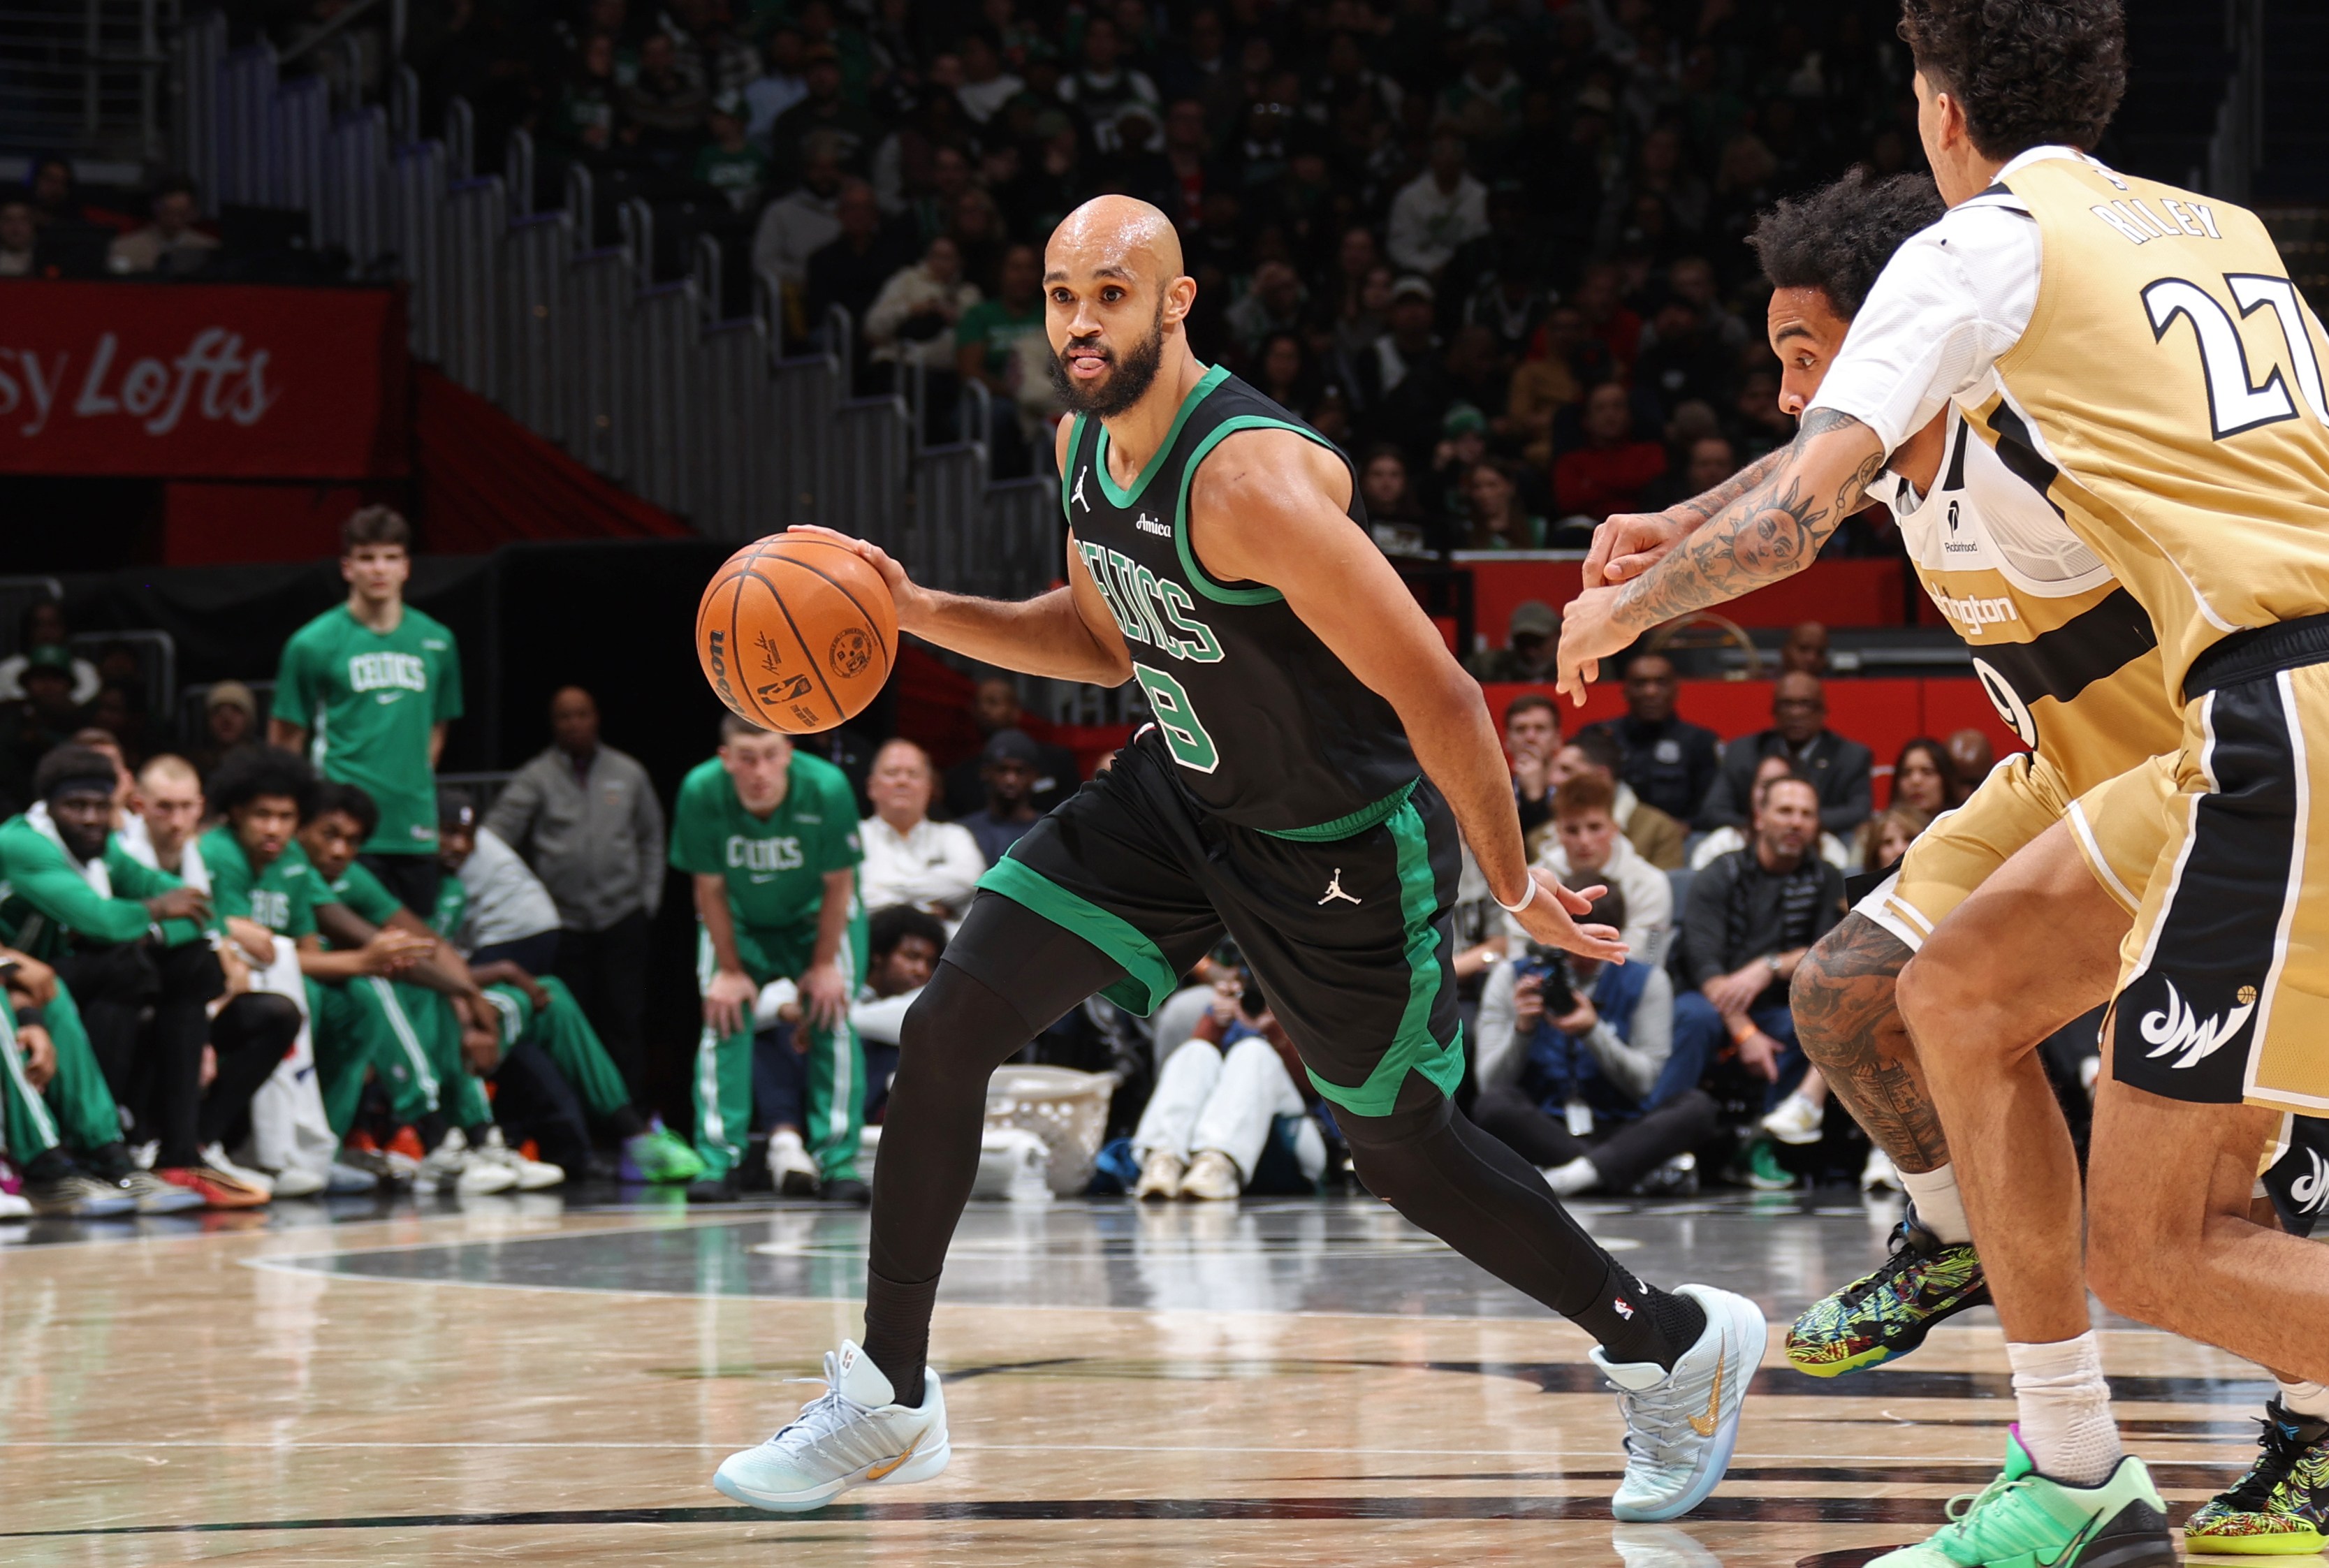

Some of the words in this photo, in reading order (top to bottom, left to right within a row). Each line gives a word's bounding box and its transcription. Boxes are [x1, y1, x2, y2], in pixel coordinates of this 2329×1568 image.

[2089, 198, 2222, 245] RILEY
[73, 327, 277, 436] Lofts
[2140, 272, 2329, 441] 27
[1136, 513, 1171, 538] Amica
[1944, 541, 1978, 553] Robinhood
[1074, 538, 1225, 663] ELTICS
[1133, 661, 1220, 775] 9
